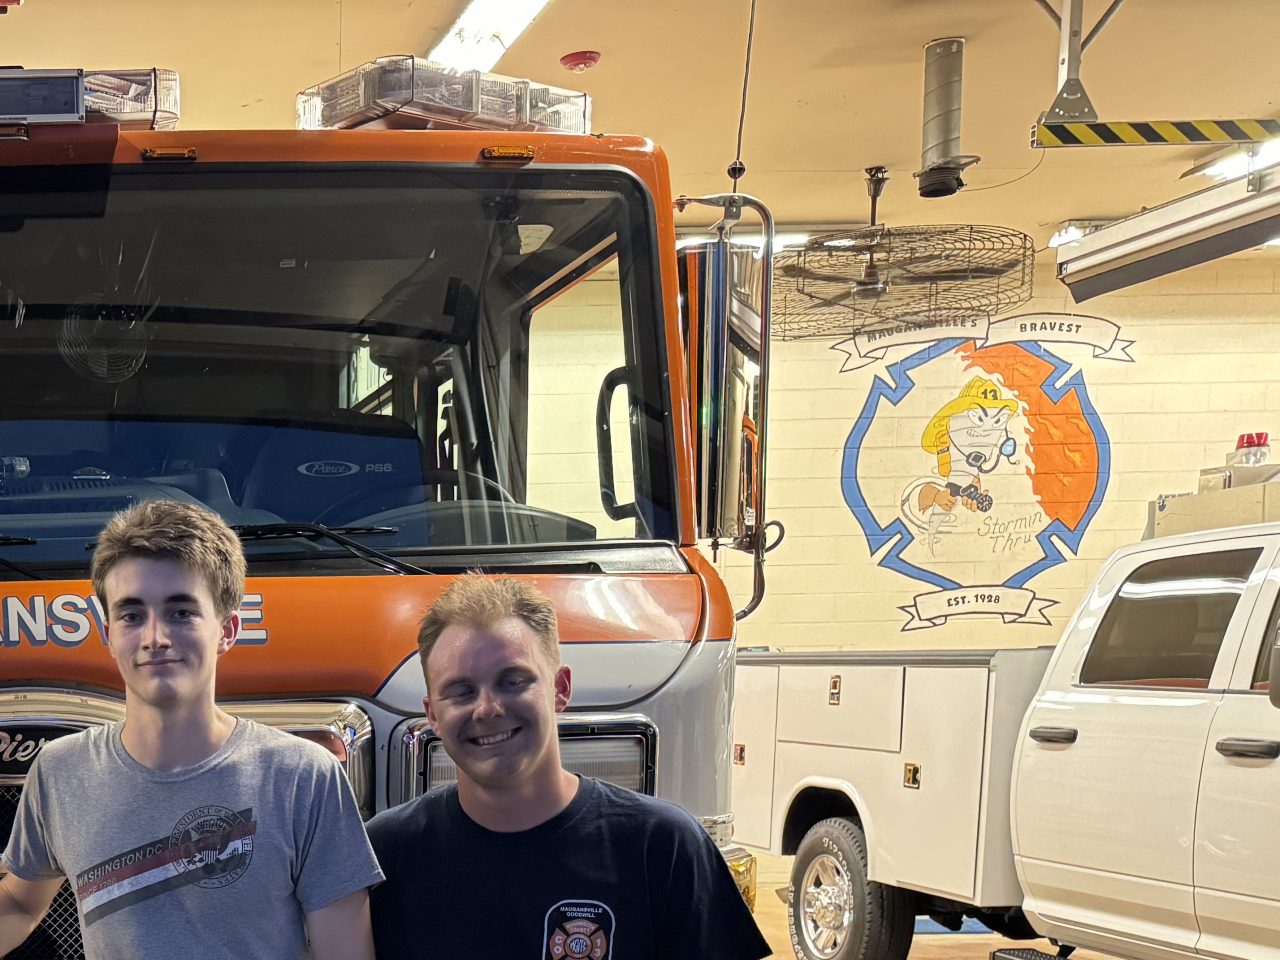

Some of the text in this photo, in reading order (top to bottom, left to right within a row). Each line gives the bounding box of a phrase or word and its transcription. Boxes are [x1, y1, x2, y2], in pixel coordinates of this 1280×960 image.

[1019, 322, 1082, 334] BRAVEST
[977, 511, 1042, 537] Stormin
[989, 533, 1032, 553] Thru
[946, 593, 1001, 607] EST. 1928
[77, 849, 144, 887] WASHINGTON
[146, 843, 163, 858] DC
[560, 906, 603, 914] MAUGANSVILLE
